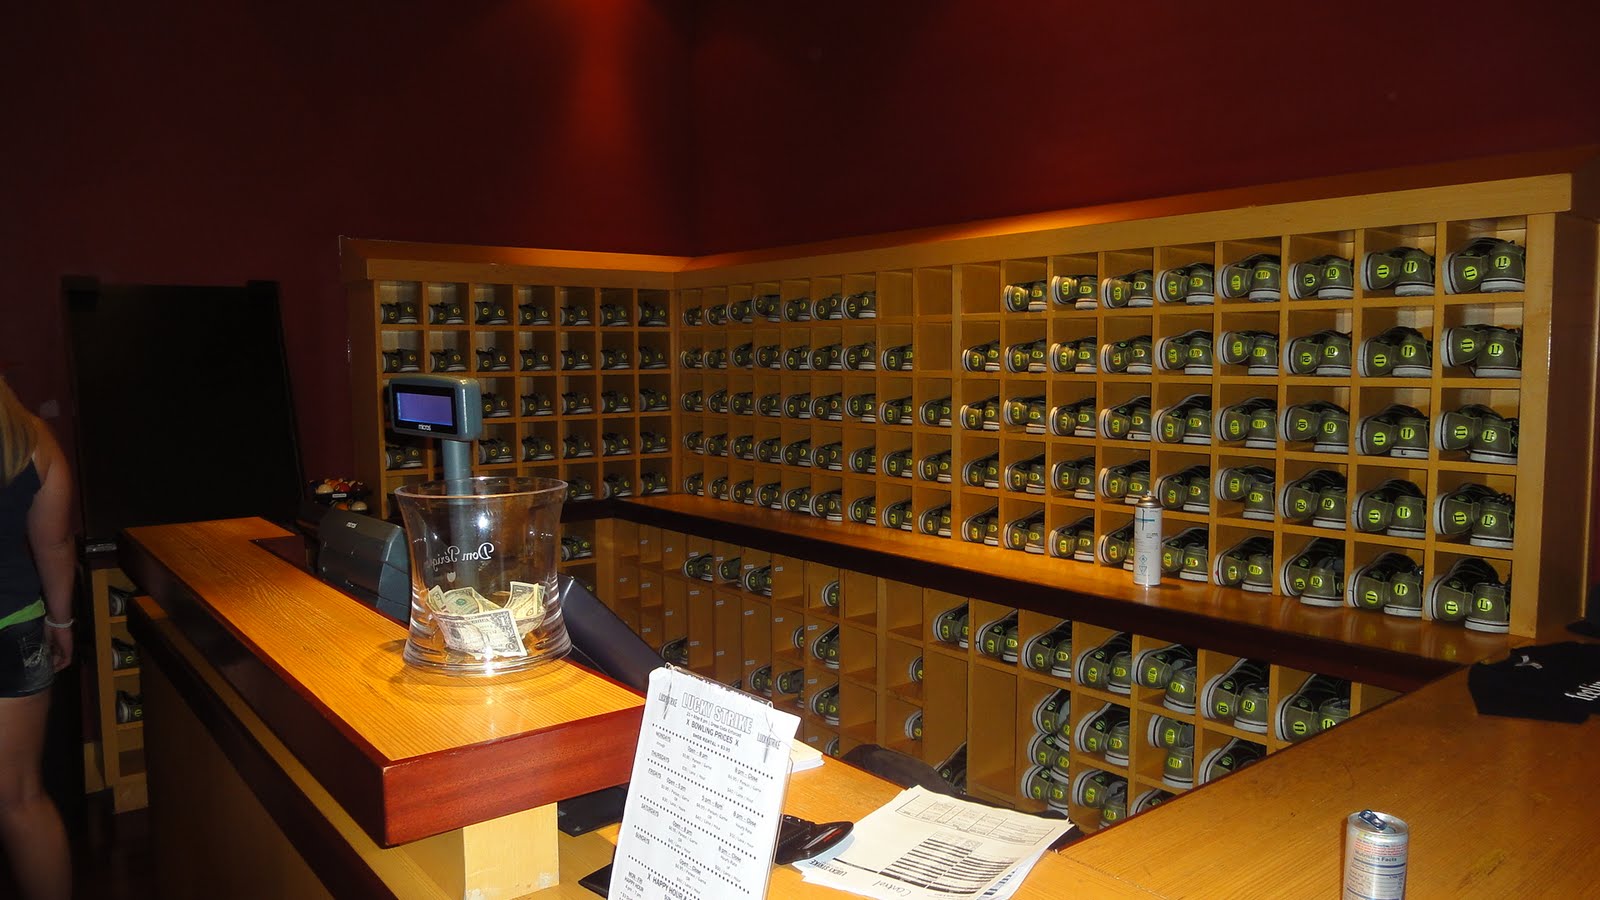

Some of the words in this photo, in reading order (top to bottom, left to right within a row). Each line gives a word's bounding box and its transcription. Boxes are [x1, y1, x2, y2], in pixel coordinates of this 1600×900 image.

[681, 692, 713, 718] LUCKY
[714, 706, 752, 734] STRIKE
[655, 731, 671, 742] MONDAYS
[691, 721, 714, 736] BOWLING
[714, 730, 733, 744] PRICES
[734, 739, 739, 747] X
[651, 750, 669, 763] THURSDAYS
[648, 768, 661, 779] FRIDAYS
[641, 803, 659, 817] SATURDAYS
[809, 859, 830, 871] STRIKE
[829, 867, 847, 877] LUCKY
[646, 872, 651, 881] X
[652, 876, 668, 891] HAPPY
[668, 886, 683, 900] HOUR
